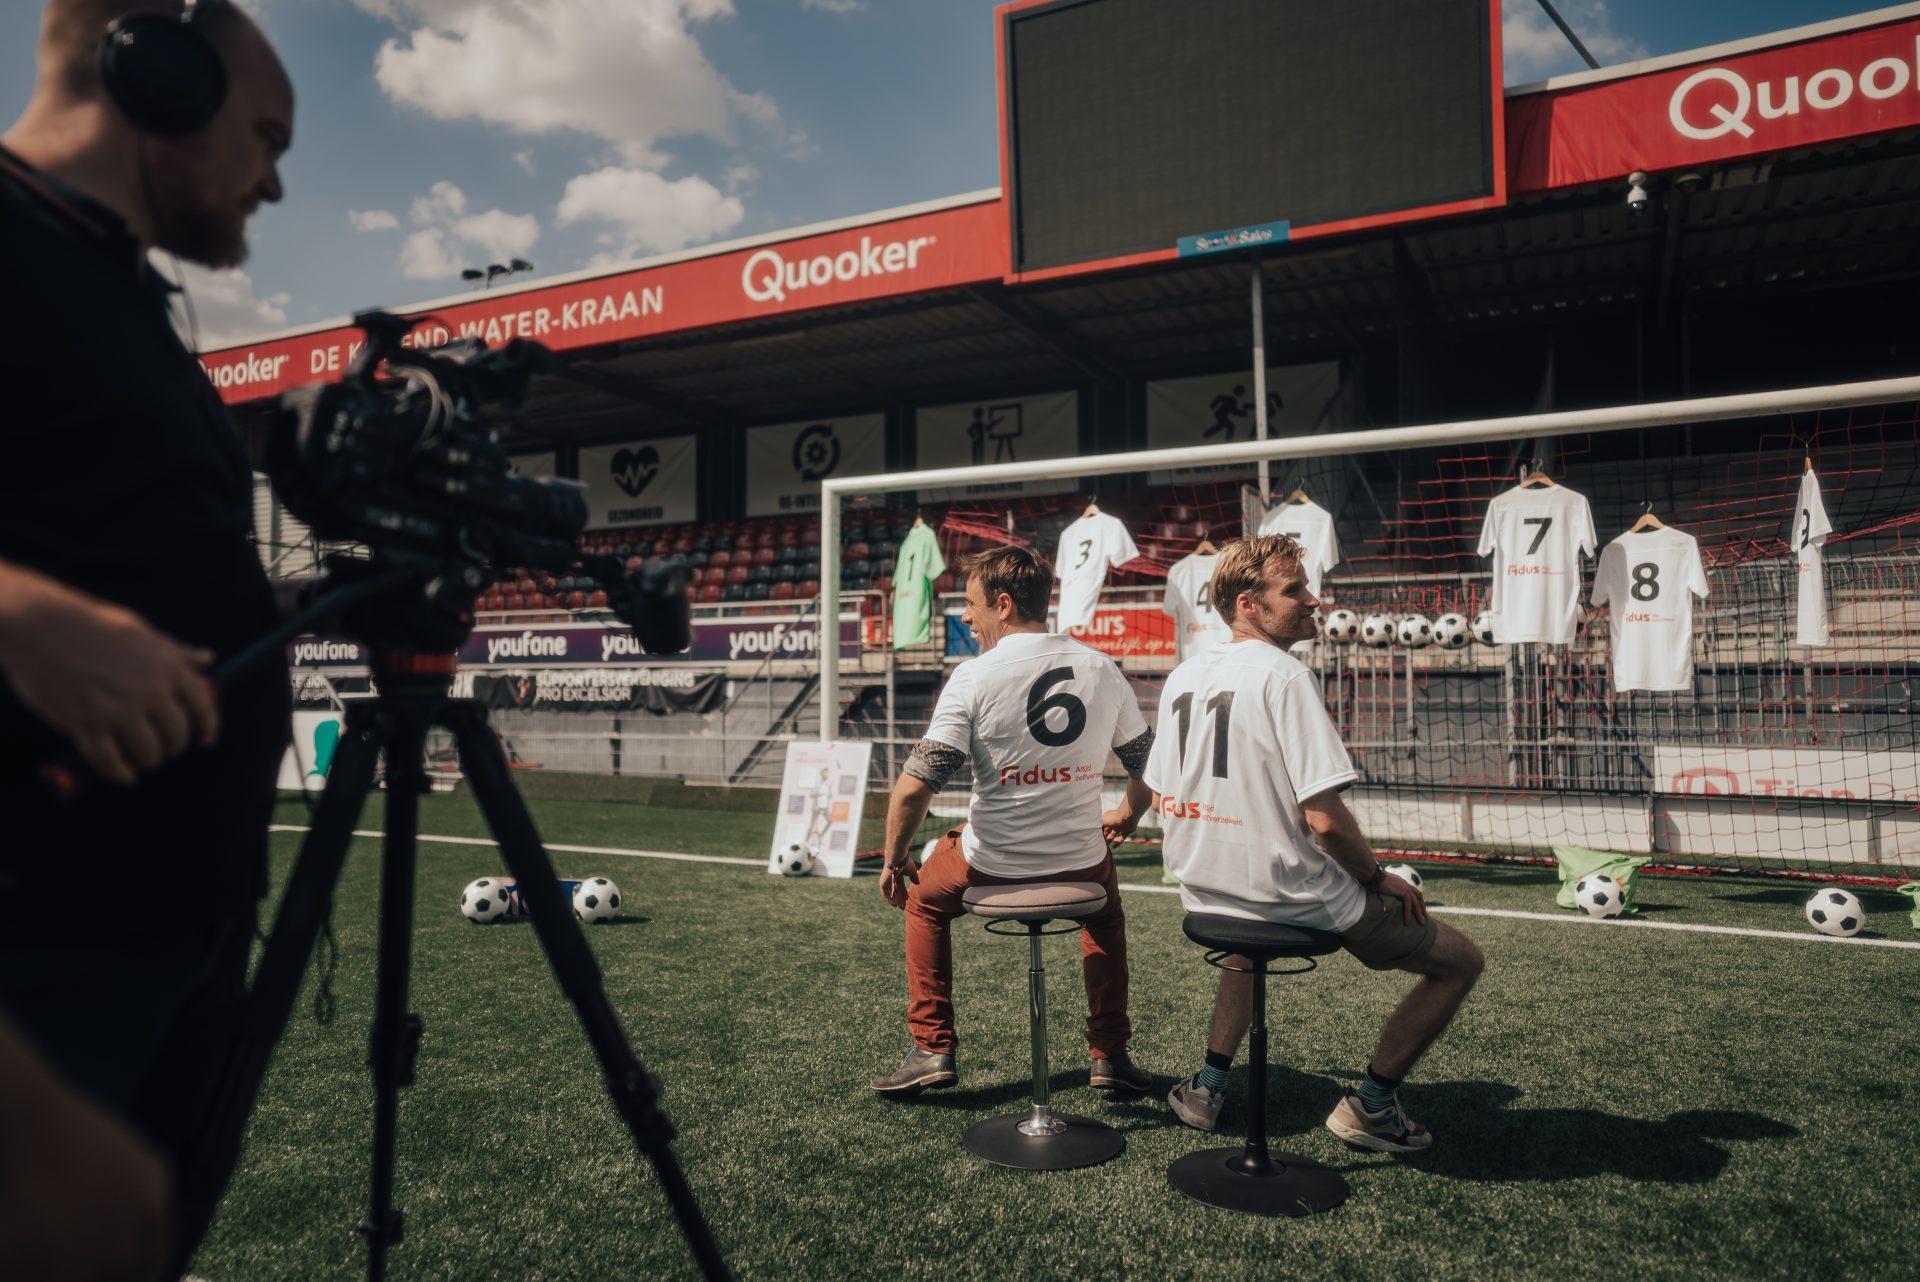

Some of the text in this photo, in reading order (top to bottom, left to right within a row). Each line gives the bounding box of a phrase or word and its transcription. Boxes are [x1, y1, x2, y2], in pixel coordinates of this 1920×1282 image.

[1669, 35, 1920, 138] Quoo
[742, 236, 924, 302] Quooker
[198, 353, 284, 388] uooker
[311, 346, 340, 374] DE
[1074, 539, 1093, 570] 3
[1523, 517, 1552, 556] 7
[908, 553, 915, 581] 1
[1630, 562, 1660, 602] 8
[1196, 581, 1212, 613] 4
[294, 640, 359, 666] youfone
[488, 631, 567, 663] youfone
[1026, 666, 1087, 747] 6
[1171, 690, 1235, 779] 11
